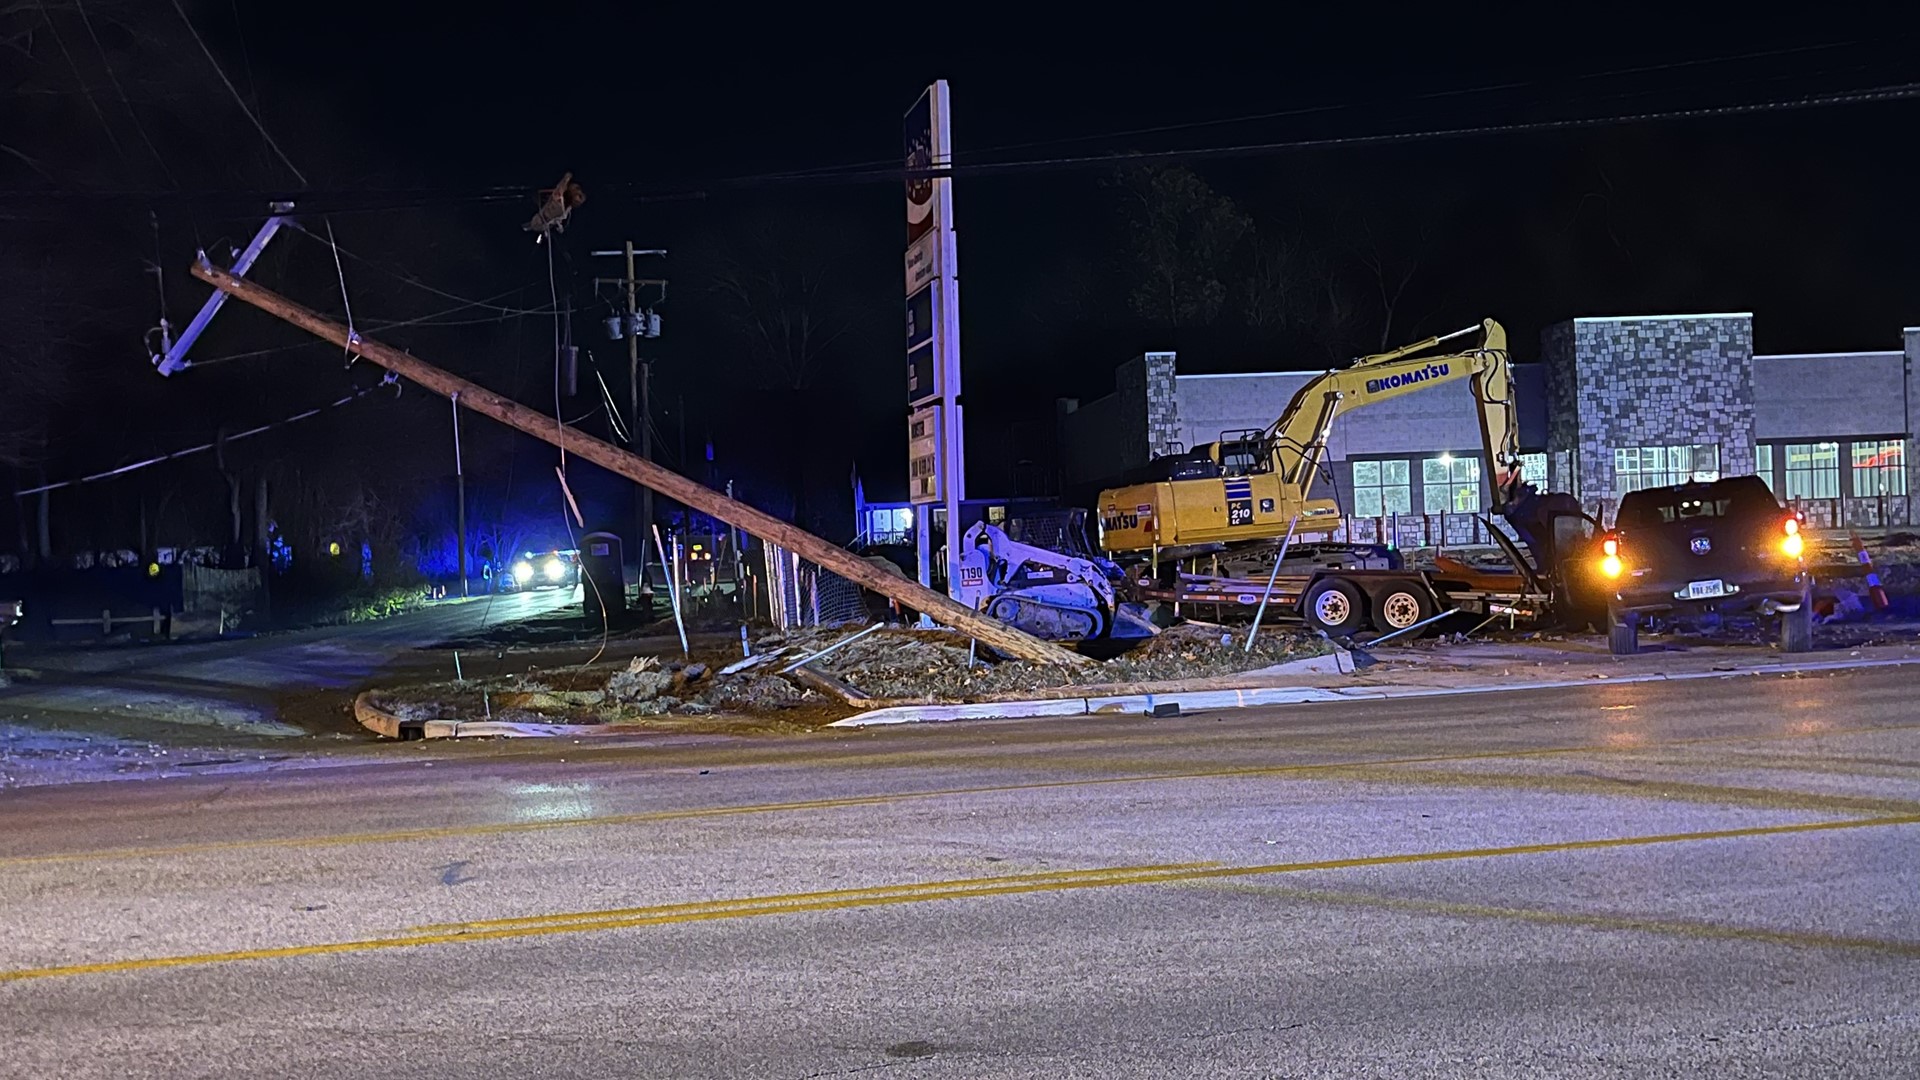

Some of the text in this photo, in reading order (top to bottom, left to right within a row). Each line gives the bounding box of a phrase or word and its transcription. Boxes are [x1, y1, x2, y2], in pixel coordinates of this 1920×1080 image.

[1380, 364, 1449, 390] KOMATSU
[1231, 509, 1251, 519] 210
[961, 567, 983, 579] T190
